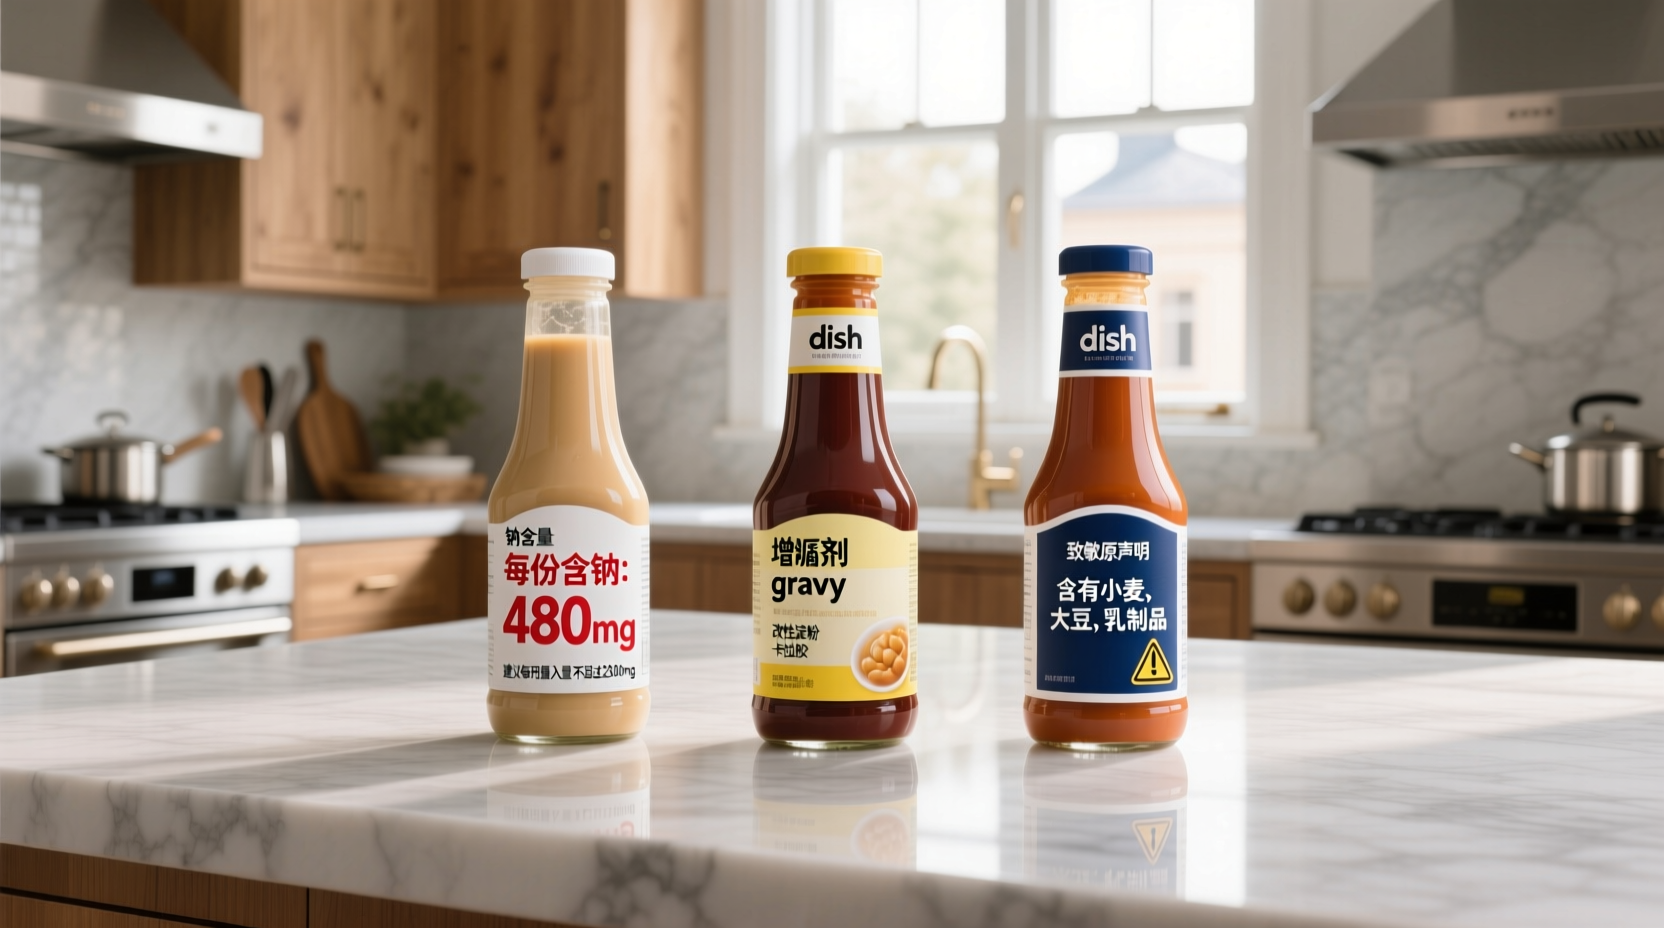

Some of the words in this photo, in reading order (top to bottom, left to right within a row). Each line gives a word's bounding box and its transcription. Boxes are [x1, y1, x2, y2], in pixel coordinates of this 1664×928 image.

[809, 323, 862, 350] dish
[1079, 324, 1137, 352] dish
[503, 551, 628, 586] 每份含钠：
[771, 576, 846, 604] gravy
[1056, 576, 1152, 603] 含有小麦，
[503, 595, 636, 651] 480mg
